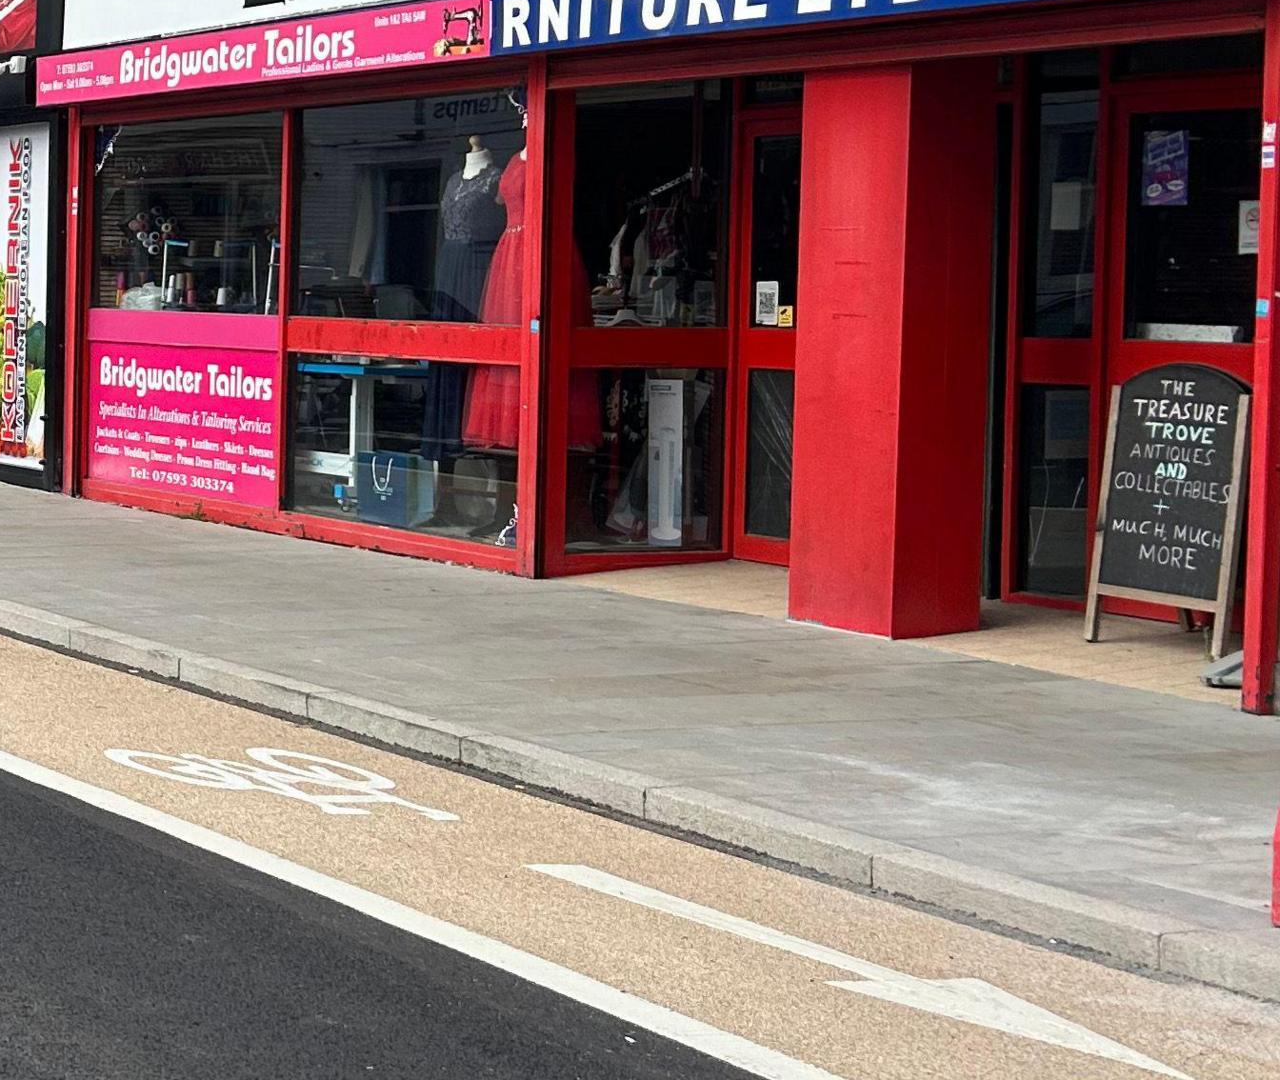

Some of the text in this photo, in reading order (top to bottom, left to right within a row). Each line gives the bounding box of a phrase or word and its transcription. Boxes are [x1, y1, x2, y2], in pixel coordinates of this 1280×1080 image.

[119, 25, 355, 87] Bridgwater Tailors
[261, 62, 301, 77] Professional
[302, 60, 324, 74] Ladies
[354, 56, 384, 68] Garment
[385, 51, 425, 64] Alterations
[1, 138, 23, 443] KOPERNIK
[16, 137, 31, 441] EASTERN EUROPEAN FOOD
[100, 356, 272, 401] Bridgwater Tailors
[1160, 379, 1195, 396] THE
[99, 401, 272, 435] Specialists In Alterations & Tailoring Services
[1133, 398, 1229, 424] TREASURE
[1144, 422, 1215, 444] TROVE
[123, 446, 149, 462] Wedding
[1130, 443, 1216, 466] ANTIQUES
[129, 466, 234, 493] Tel: 07593 303374
[1155, 462, 1188, 480] AND
[1114, 471, 1232, 504] COLLECTABLES
[1153, 499, 1170, 516] +
[1112, 519, 1223, 550] MUCH, MUCH
[1138, 544, 1198, 570] MORE
